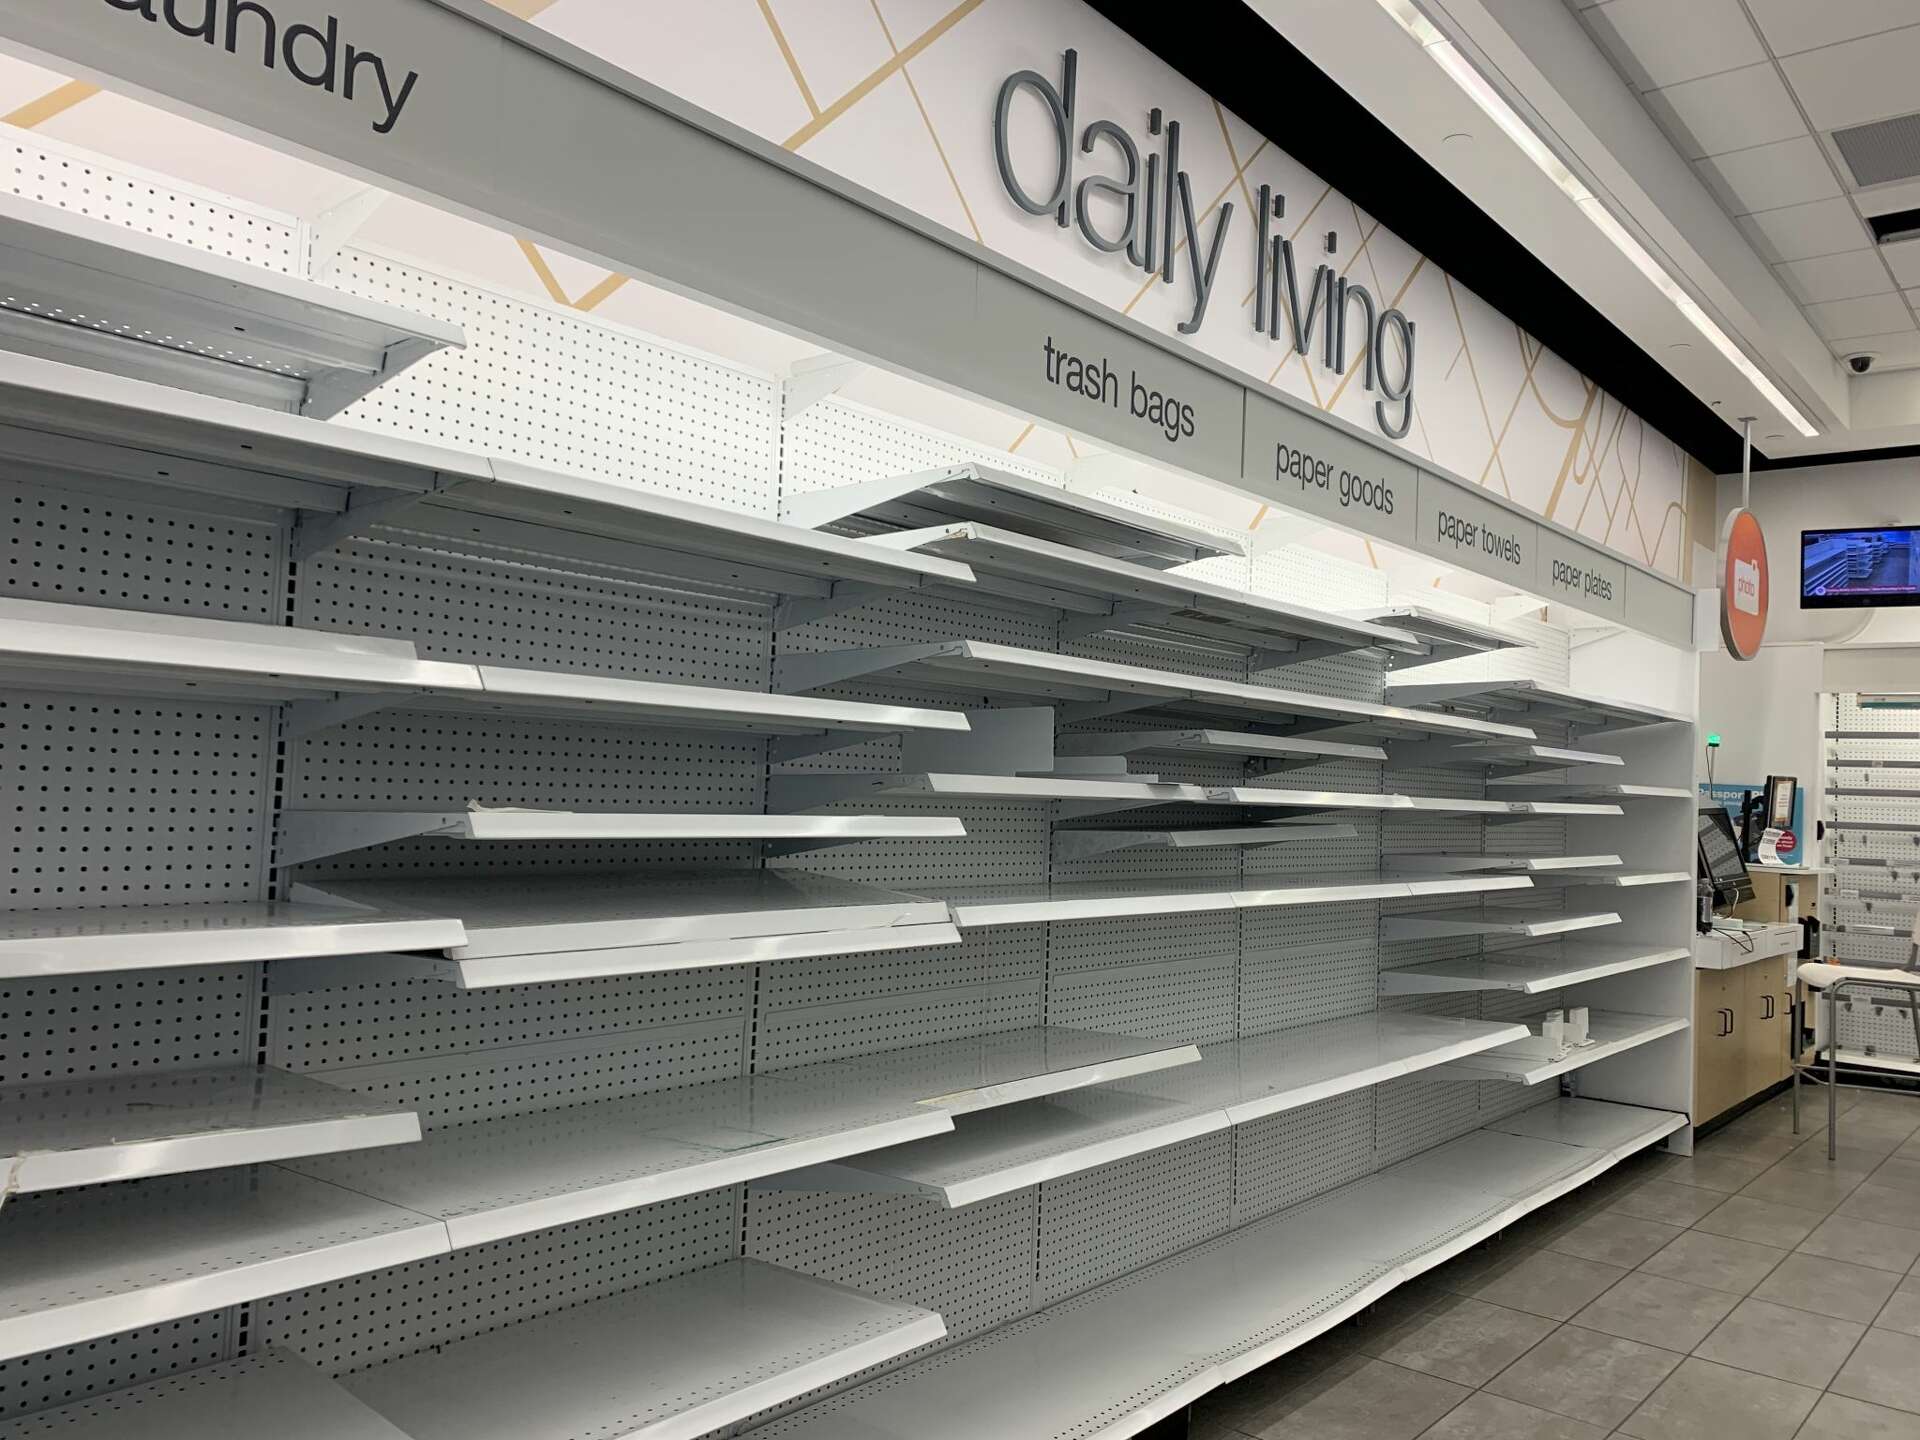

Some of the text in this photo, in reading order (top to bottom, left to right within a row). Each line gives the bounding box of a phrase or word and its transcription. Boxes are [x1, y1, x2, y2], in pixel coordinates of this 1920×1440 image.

[994, 47, 1416, 439] daily living
[1044, 335, 1195, 442] trash bags
[1276, 442, 1394, 515] paper goods
[1438, 510, 1521, 565] paper towels
[1552, 558, 1612, 601] paper plates
[1698, 788, 1746, 799] Passpor
